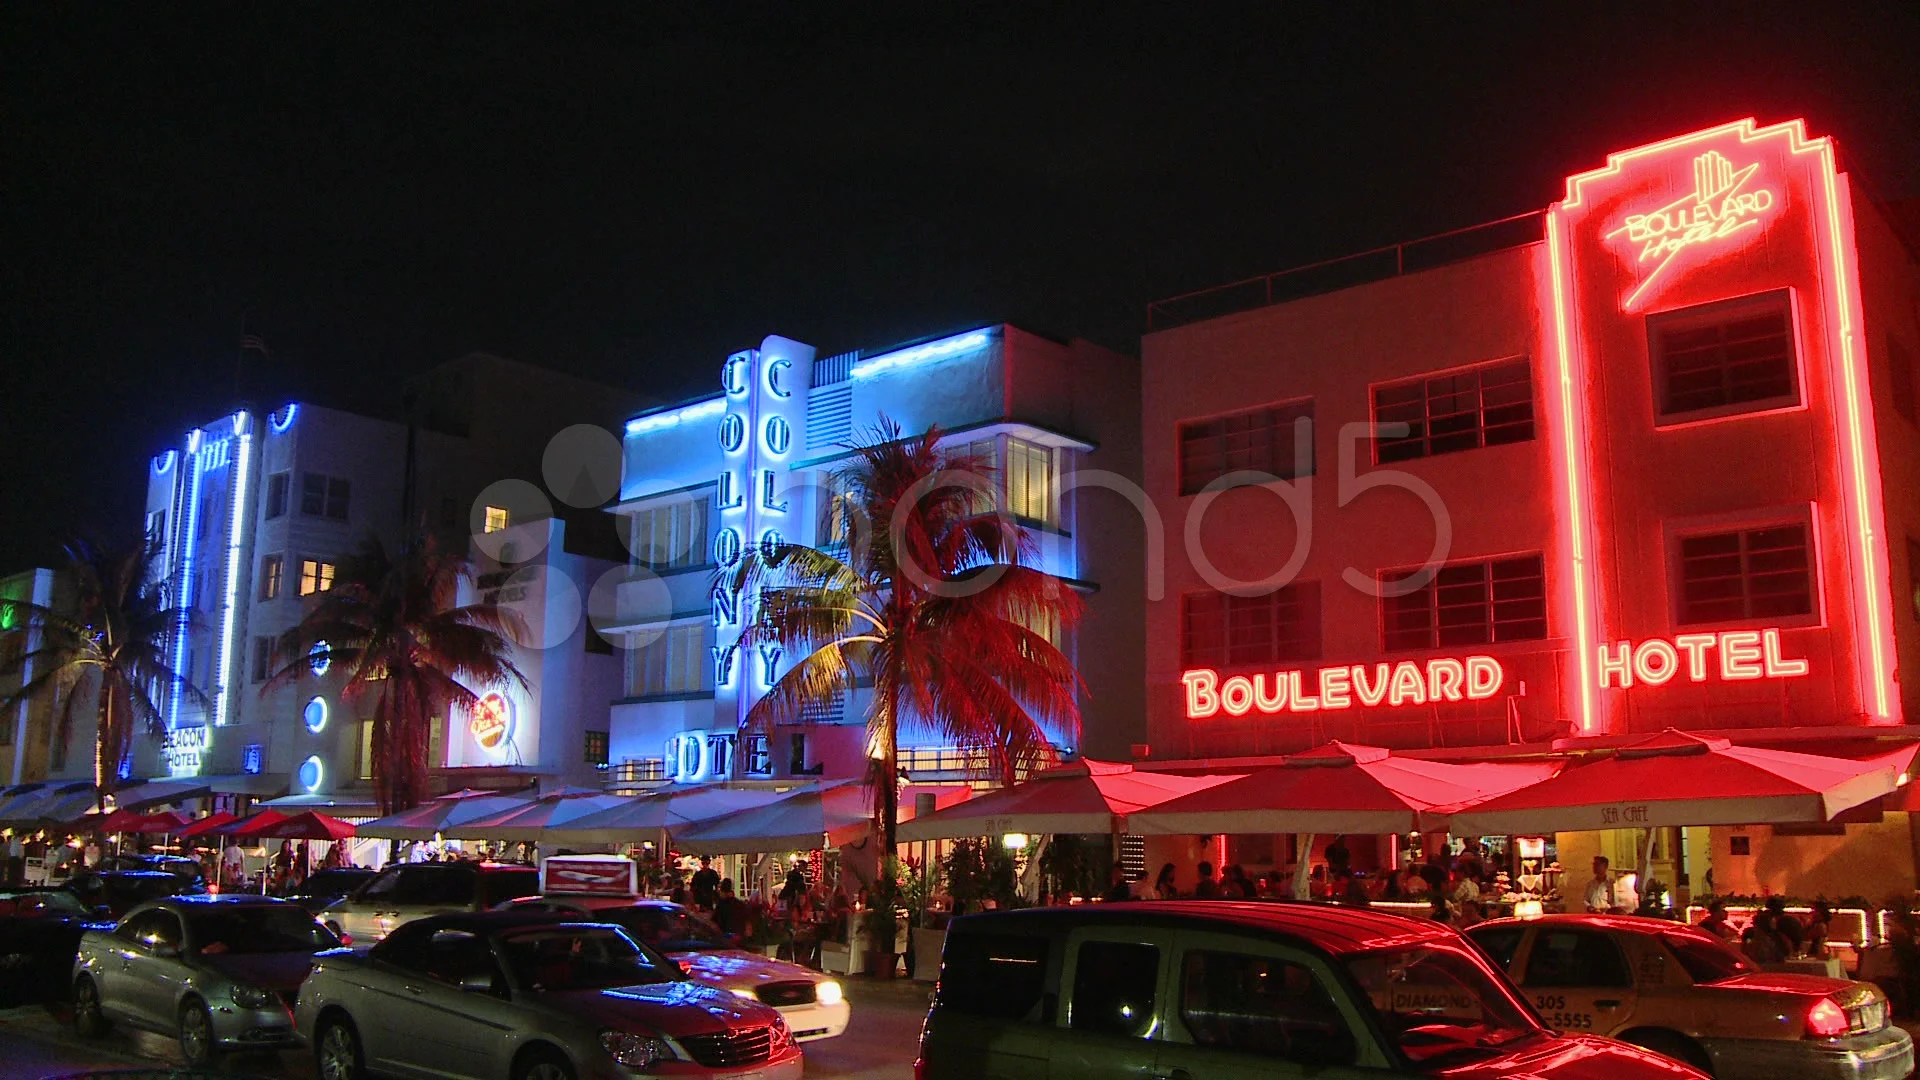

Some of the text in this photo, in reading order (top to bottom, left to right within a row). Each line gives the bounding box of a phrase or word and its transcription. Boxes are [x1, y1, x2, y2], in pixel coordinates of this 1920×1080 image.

[1625, 189, 1773, 242] BOULEVARD
[709, 356, 746, 686] COLONY
[759, 359, 793, 688] COLOY
[1181, 626, 1811, 720] BOULEVARD HOTEL
[161, 726, 206, 749] BEACON
[167, 751, 200, 767] HOTEL
[1395, 993, 1471, 1009] DIAMOND
[1535, 995, 1566, 1010] 305
